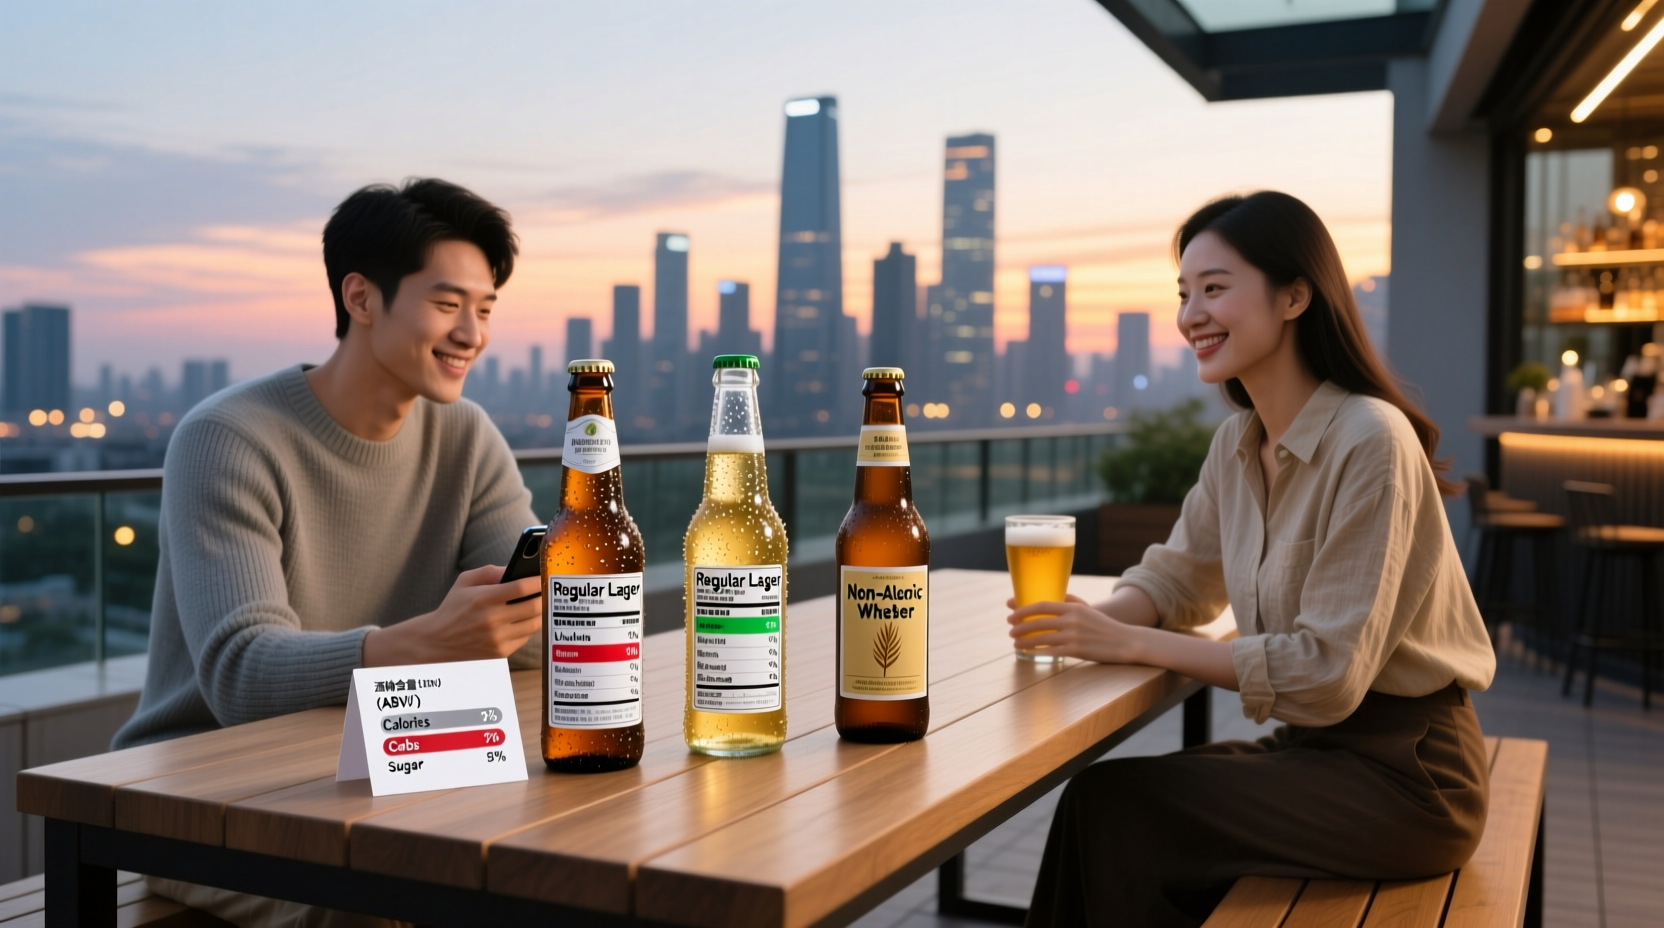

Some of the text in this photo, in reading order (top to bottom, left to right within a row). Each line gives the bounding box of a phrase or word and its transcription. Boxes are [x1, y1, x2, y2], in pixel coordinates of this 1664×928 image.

[696, 571, 781, 593] Regular Lager
[608, 582, 640, 601] Lager
[383, 717, 431, 731] Calories
[388, 760, 424, 775] Sugar
